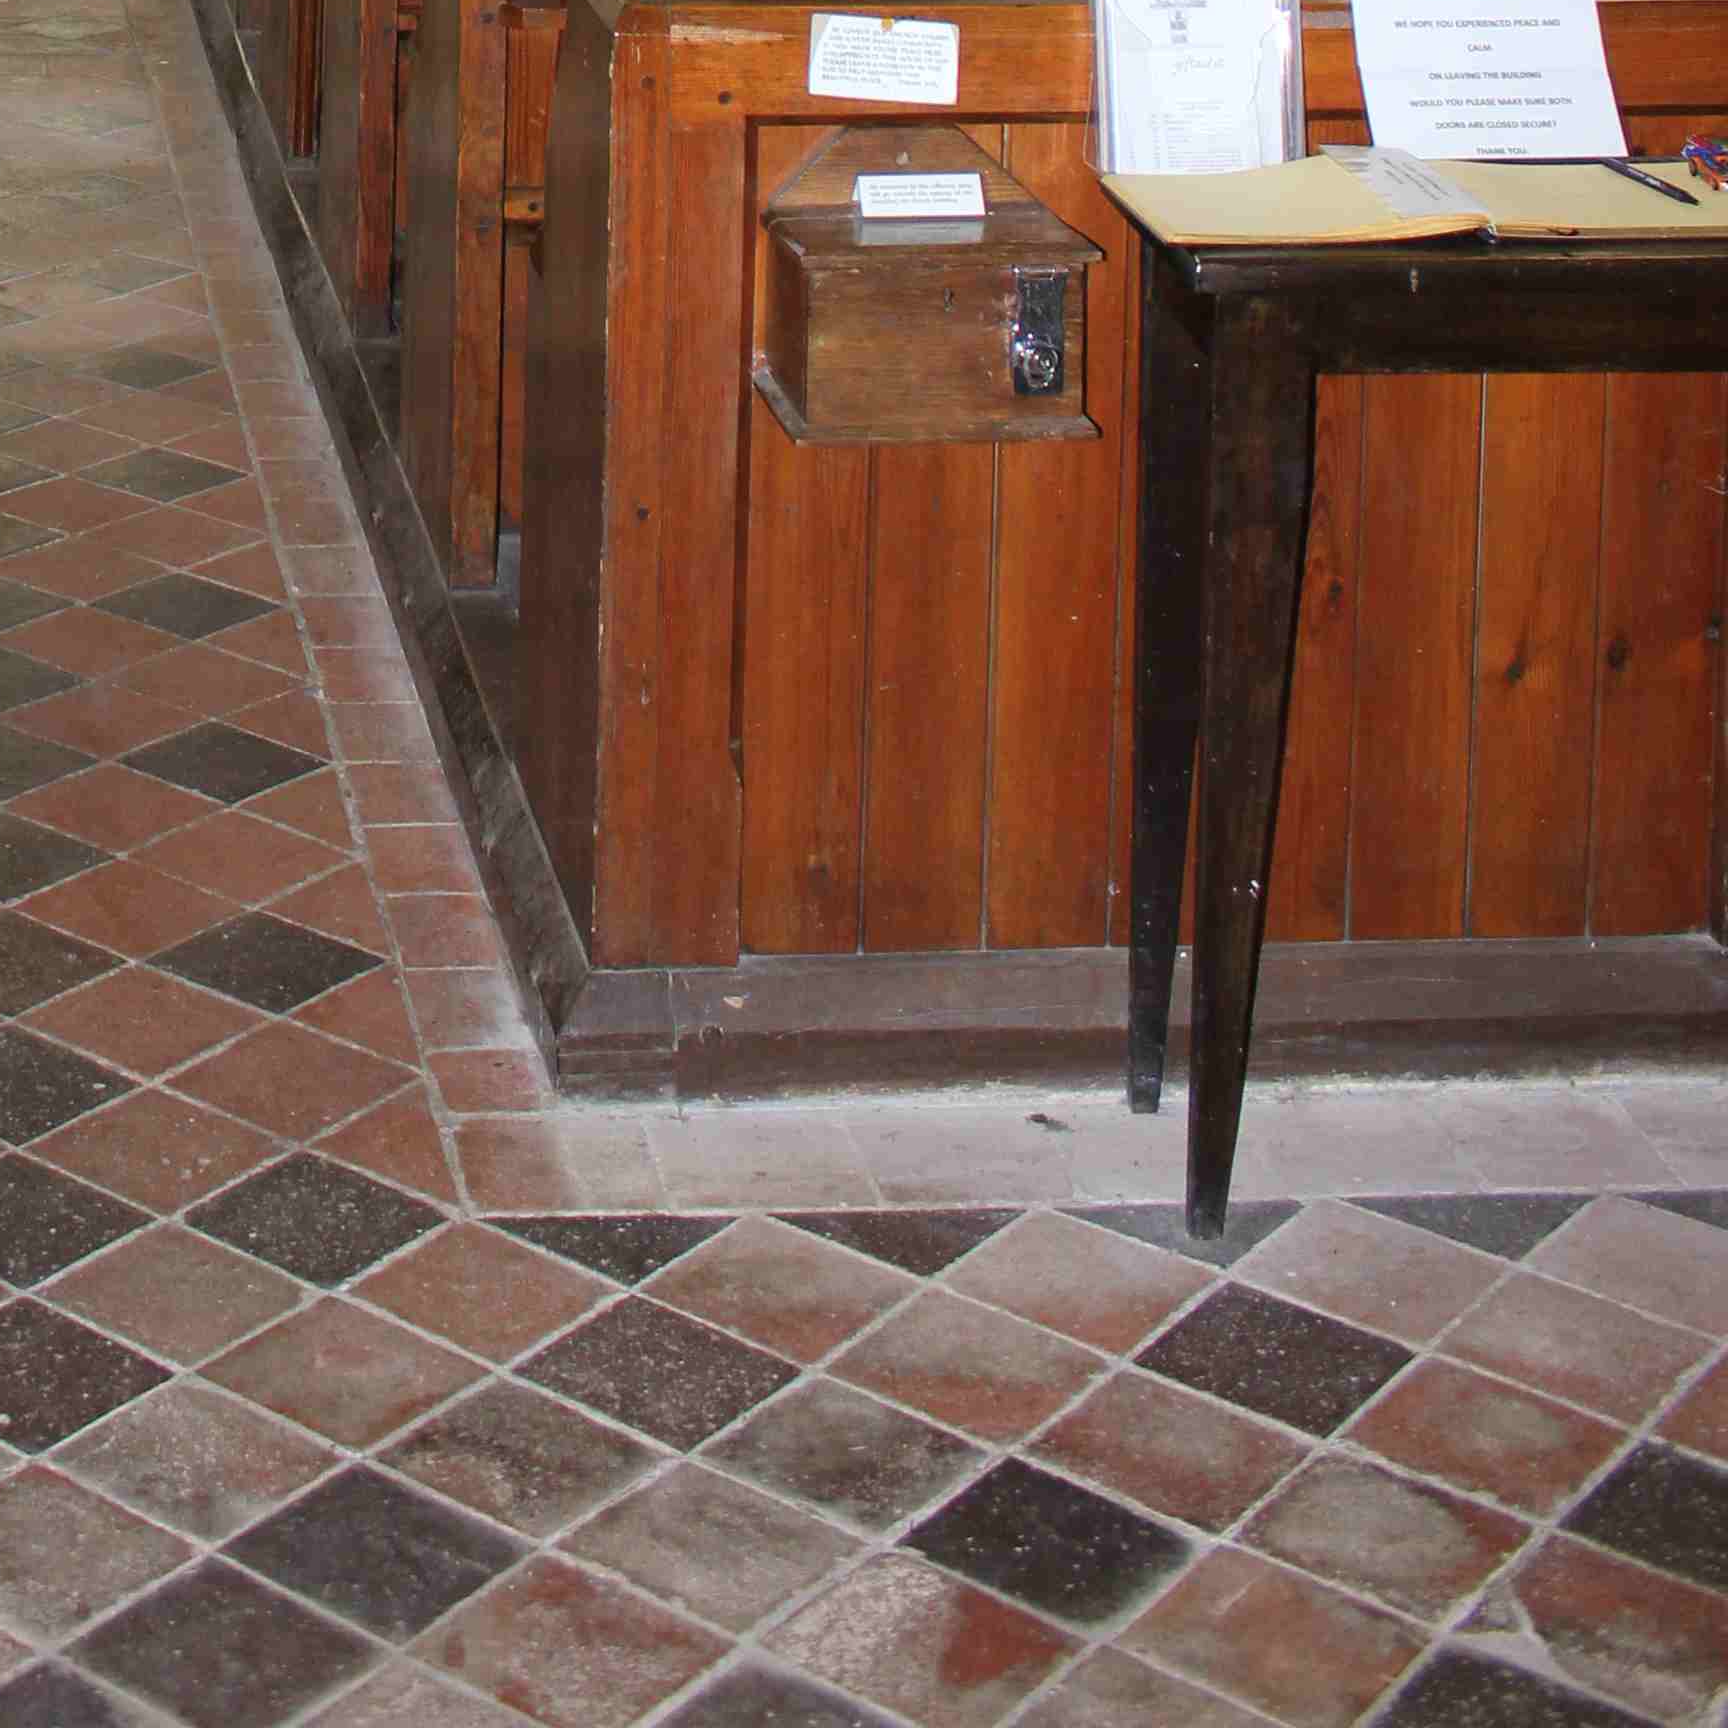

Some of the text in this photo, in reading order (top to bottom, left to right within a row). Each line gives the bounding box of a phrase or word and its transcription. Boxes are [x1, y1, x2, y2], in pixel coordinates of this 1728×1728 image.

[1394, 19, 1561, 28] WE HOPE YOU EXPERIENCED PEACE AND
[1428, 72, 1442, 80] ON
[1444, 72, 1481, 80] LEAVING
[1482, 72, 1500, 80] THE
[1409, 99, 1443, 107] WOULD
[1444, 98, 1463, 106] YOU
[1465, 98, 1496, 106] PLEASE
[1497, 97, 1523, 106] MAKE
[1524, 97, 1546, 105] SURE
[1435, 121, 1466, 129] DOORS
[1486, 120, 1519, 128] CLOSED
